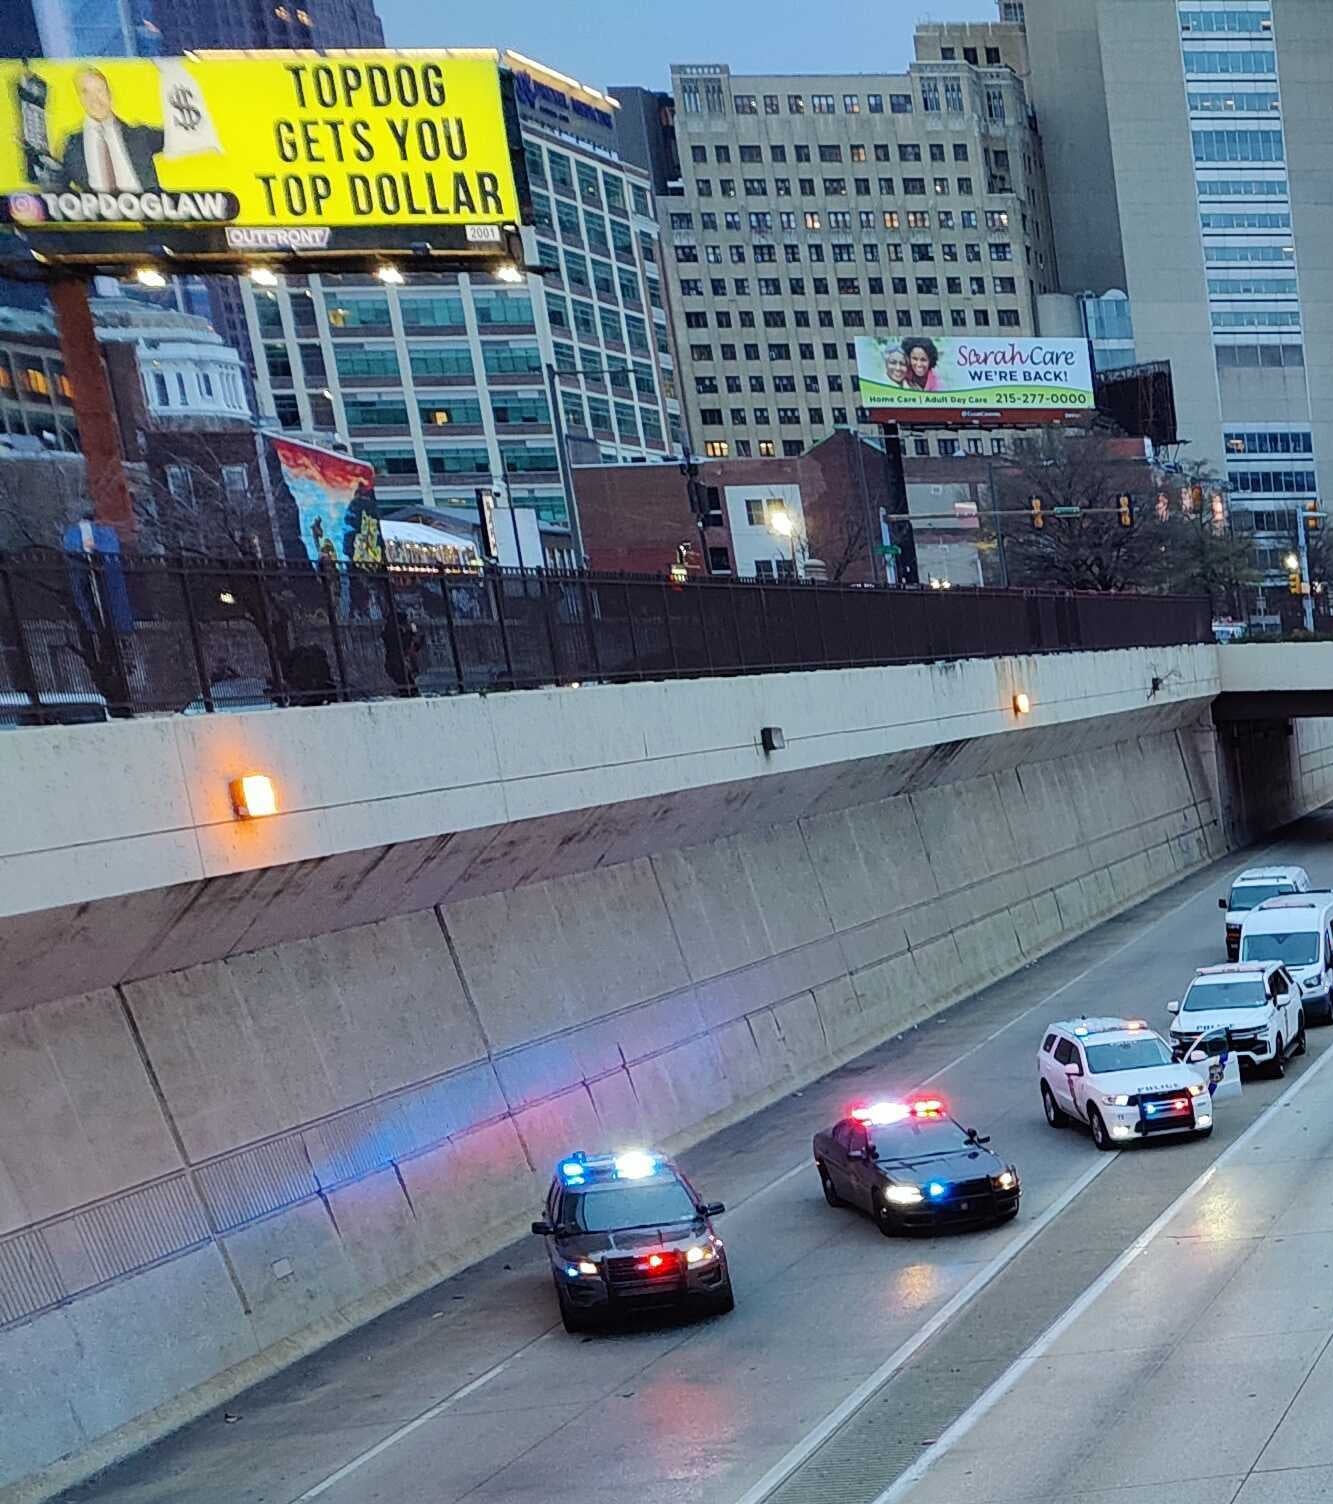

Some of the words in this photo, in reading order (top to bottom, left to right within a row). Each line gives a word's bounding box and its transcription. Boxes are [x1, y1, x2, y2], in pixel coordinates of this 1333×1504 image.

[284, 63, 446, 109] TOPDOG
[274, 119, 376, 163] GETS
[391, 117, 468, 162] YOU
[256, 172, 332, 217] TOP
[347, 170, 504, 217] DOLLAR
[43, 192, 229, 221] TOPDOGLAW
[230, 227, 327, 248] OUTFRONT
[469, 227, 498, 241] 2001
[957, 343, 1075, 366] SarahCare
[968, 370, 1018, 382] WE'RE
[1023, 370, 1068, 382] BACK!
[869, 395, 894, 403] Home
[897, 395, 917, 403] Care
[925, 395, 948, 403] Adult
[950, 396, 967, 405] Day
[968, 396, 987, 404] Care
[995, 392, 1086, 404] 215-277-0000
